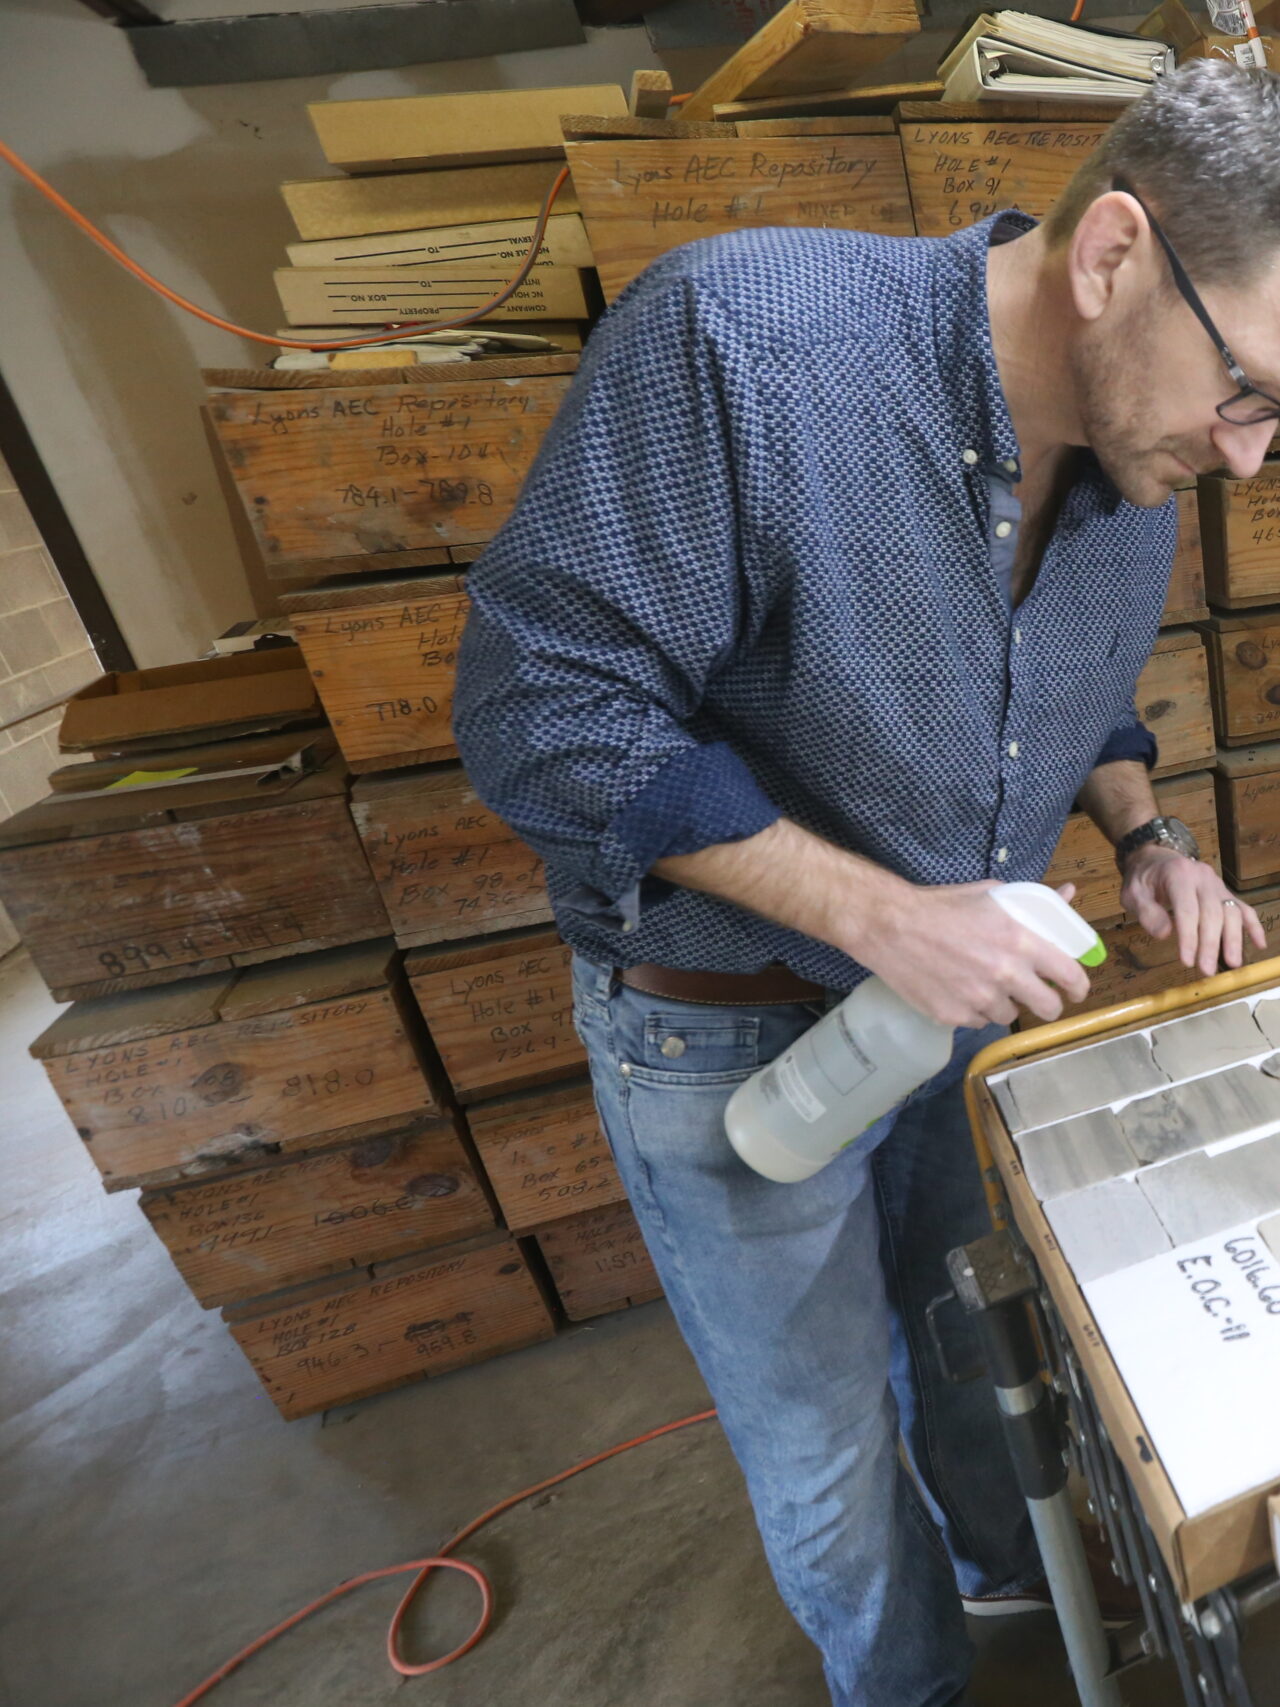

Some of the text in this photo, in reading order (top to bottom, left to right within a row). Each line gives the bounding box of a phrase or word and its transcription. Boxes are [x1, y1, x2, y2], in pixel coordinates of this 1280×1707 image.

[914, 128, 973, 146] LYONS
[983, 129, 1020, 146] AEC
[614, 146, 878, 195] Lyons AEC Repository
[934, 155, 979, 173] HOLE
[652, 199, 709, 228] Hole
[427, 245, 441, 255] TO
[420, 280, 432, 288] TO
[368, 293, 387, 302] BOX
[399, 304, 547, 315] COMPANY PROPERTY
[252, 387, 530, 434] Lyons AEC Repository
[382, 416, 428, 439] Hole
[325, 616, 385, 641] Lyons
[399, 603, 442, 627] AEC
[384, 814, 488, 850] Lyons AEC
[399, 883, 449, 907] Box
[450, 969, 505, 1005] Lyons
[517, 956, 551, 978] AEC
[471, 998, 516, 1024] Hole
[489, 1020, 533, 1044] Box
[65, 1046, 148, 1074] LYONS
[85, 1063, 149, 1088] HOLE
[281, 1067, 375, 1098] 818.0
[521, 1167, 560, 1189] Box
[183, 1182, 246, 1201] YONS
[258, 1308, 311, 1333] LYONS
[369, 1258, 467, 1298] REPOSITORY
[272, 1322, 314, 1346] HOLE
